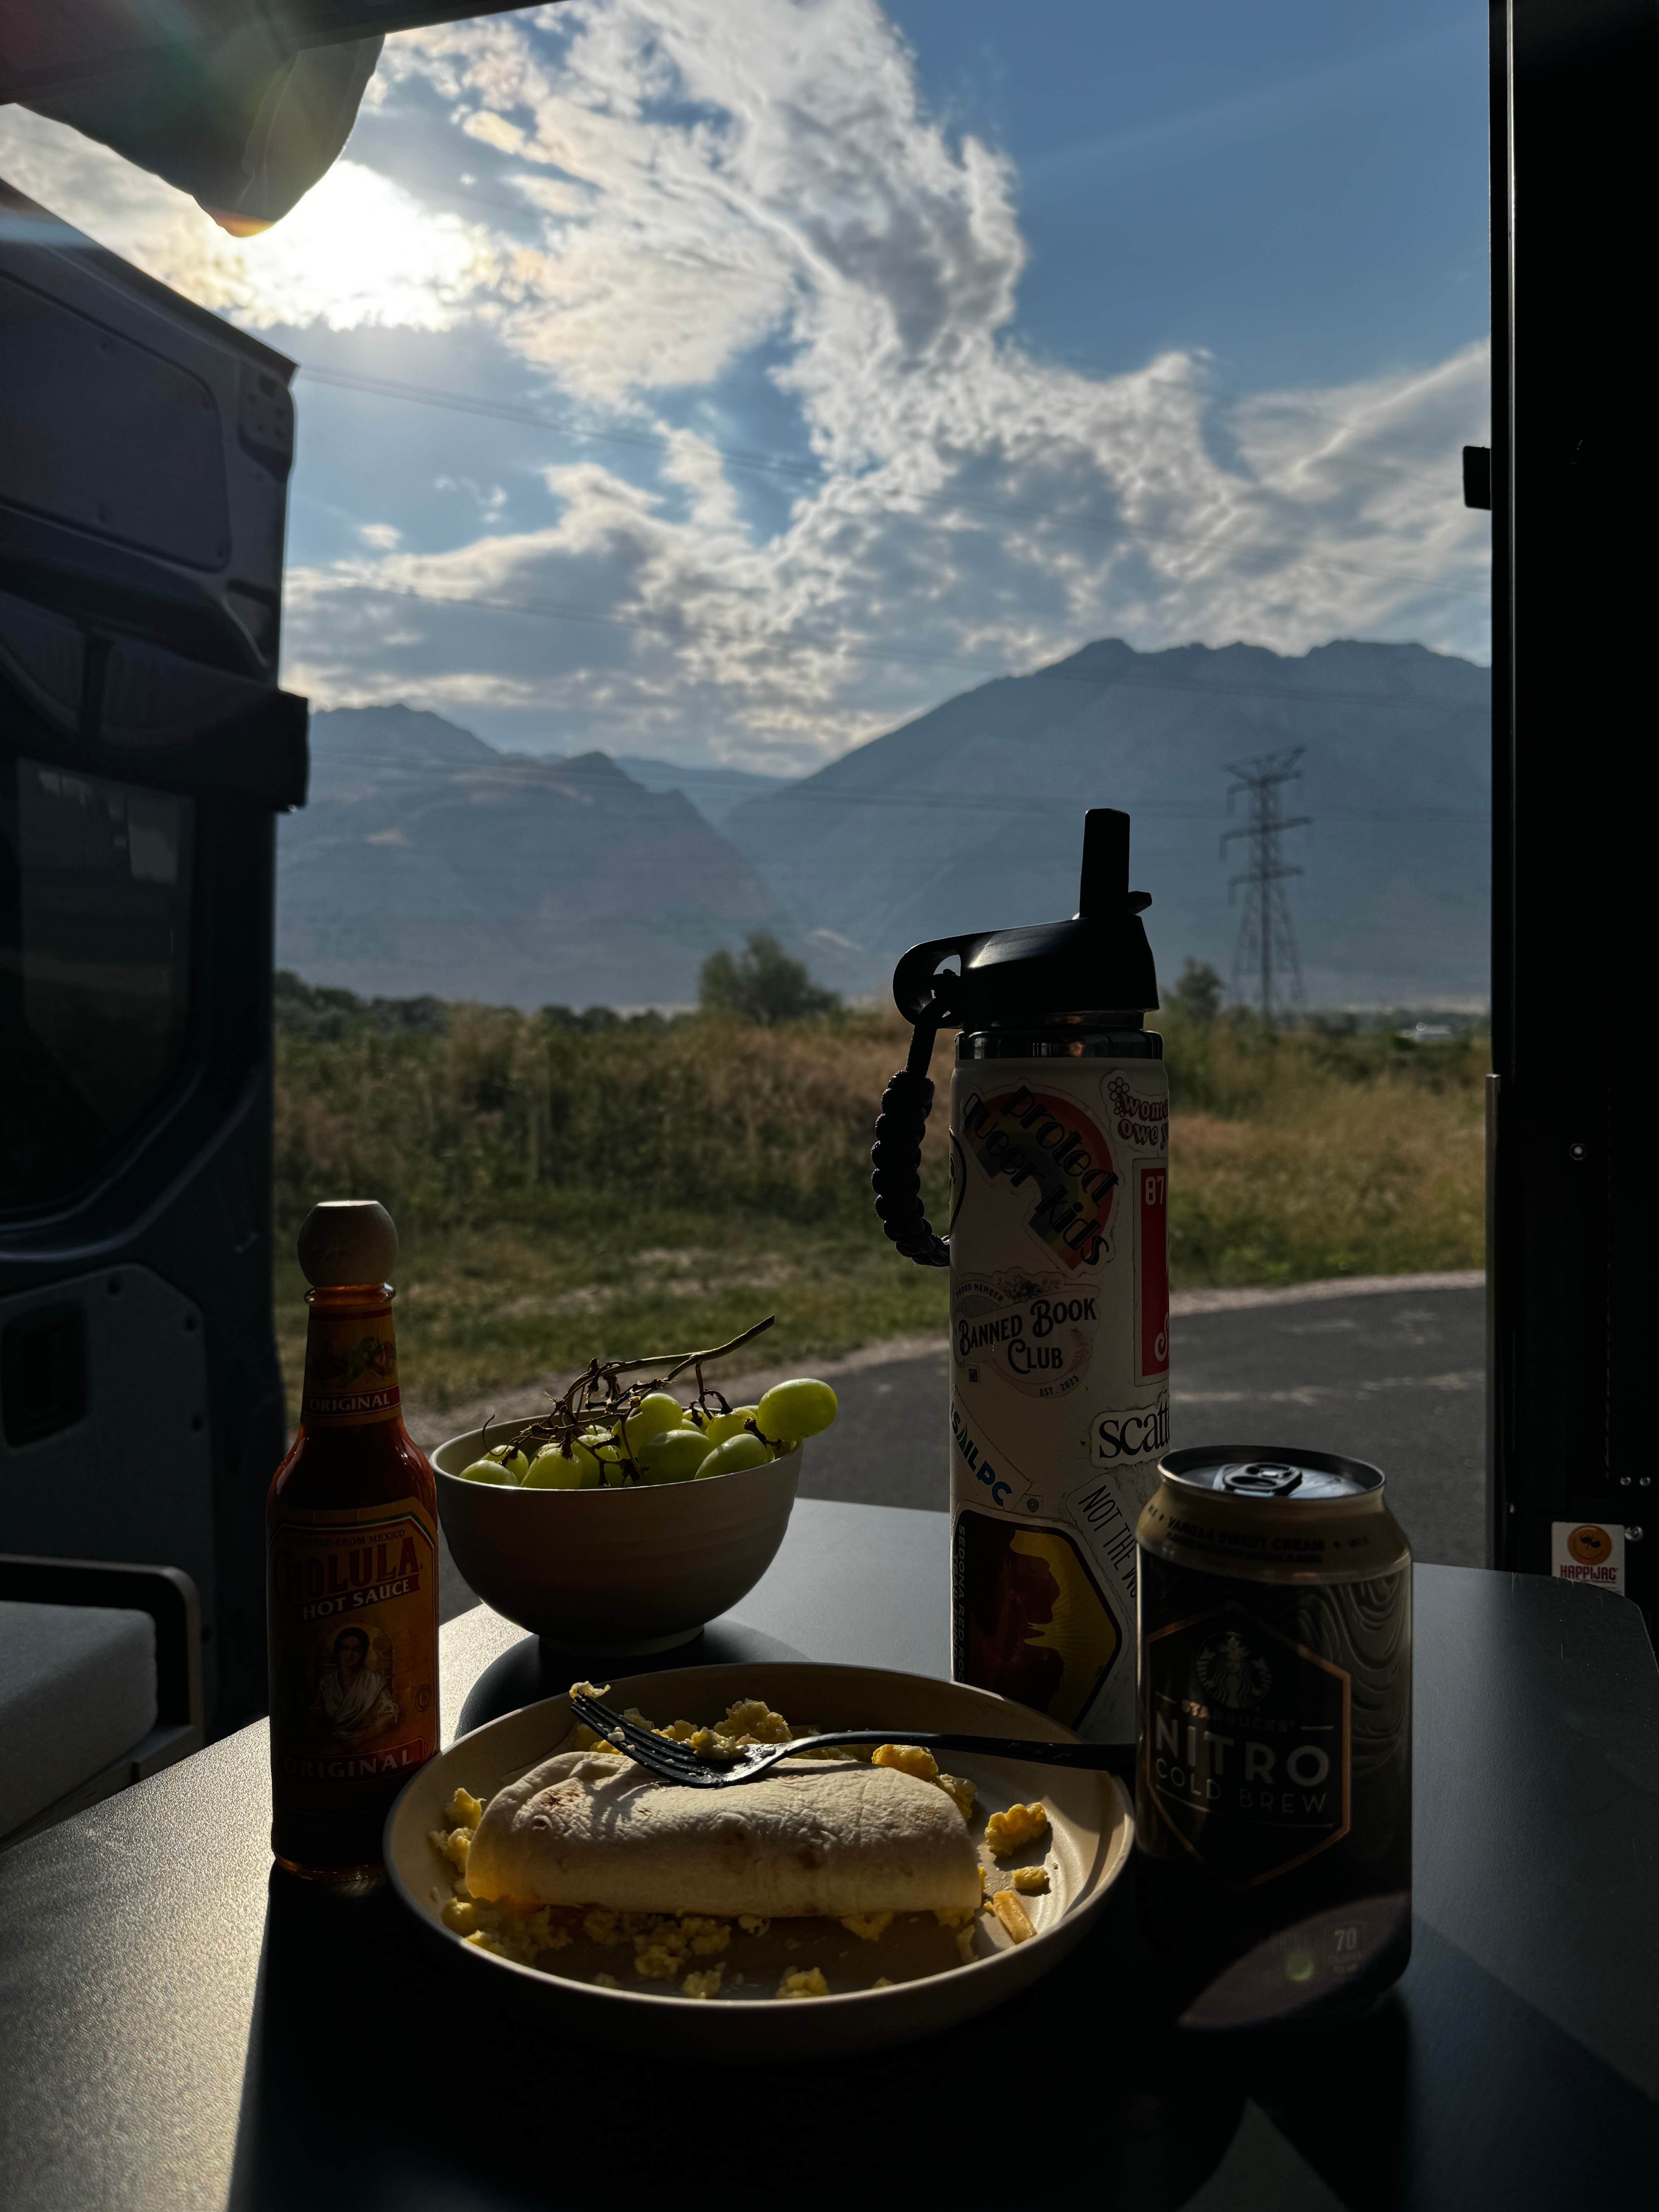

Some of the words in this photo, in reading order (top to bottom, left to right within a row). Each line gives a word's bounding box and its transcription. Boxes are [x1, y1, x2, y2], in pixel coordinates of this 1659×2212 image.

[1118, 1119, 1159, 1145] owe
[1145, 1175, 1165, 1206] 87
[1035, 1184, 1109, 1265] kids
[956, 1283, 971, 1298] PROUD
[974, 1283, 1003, 1303] MEMBER
[959, 1315, 1023, 1355] BANNED
[1030, 1298, 1097, 1337] BOOK
[1008, 1339, 1063, 1374] CLUB
[1039, 1387, 1058, 1396] EST.
[1060, 1375, 1079, 1391] 2023
[310, 1396, 390, 1412] ORIGINAL
[1099, 1399, 1170, 1458] scatt
[1078, 1485, 1123, 1532] NOT
[368, 1529, 405, 1543] MEXICO
[1560, 1565, 1616, 1580] HAPPIJAC
[304, 1596, 346, 1621] HOT
[352, 1579, 410, 1607] SAUCE
[284, 1748, 413, 1779] ORIGINAL
[1155, 1709, 1330, 1788] NITRO
[1155, 1757, 1222, 1800] COLD
[1239, 1788, 1327, 1814] BREW
